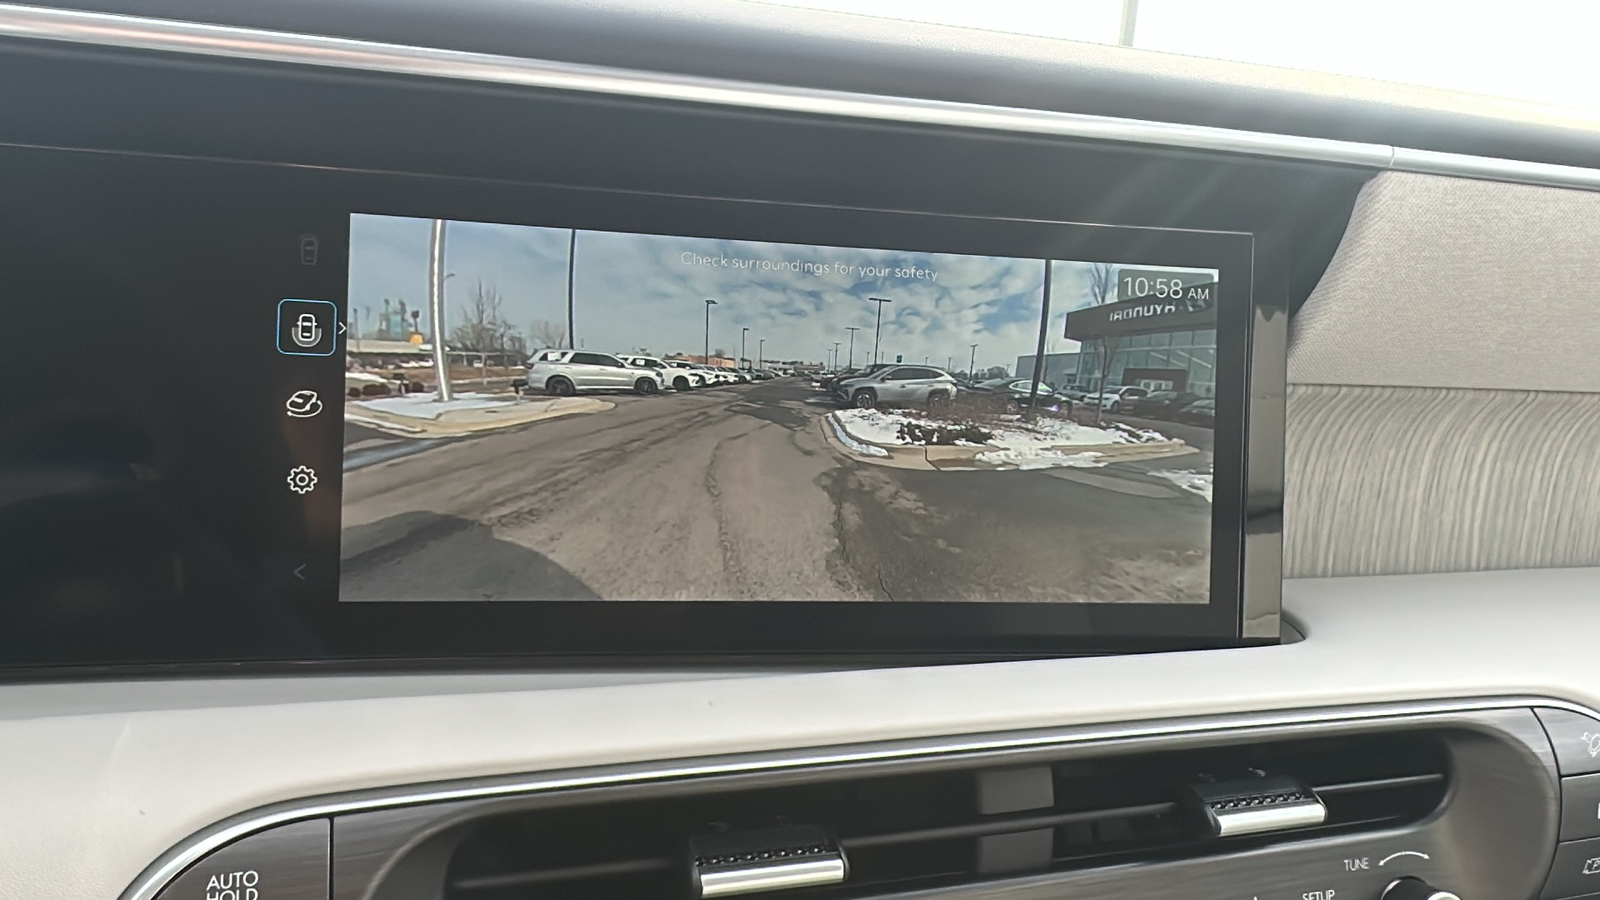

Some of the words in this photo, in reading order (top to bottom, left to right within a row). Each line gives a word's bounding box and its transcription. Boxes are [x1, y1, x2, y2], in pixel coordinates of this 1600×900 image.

[680, 251, 729, 268] Check
[731, 255, 830, 276] surroundings
[833, 261, 856, 275] for
[858, 266, 892, 278] your
[894, 264, 939, 282] safety
[1123, 277, 1183, 299] 10:58
[1187, 287, 1209, 300] AM
[1343, 857, 1370, 871] TUNE
[206, 870, 259, 891] AUTO
